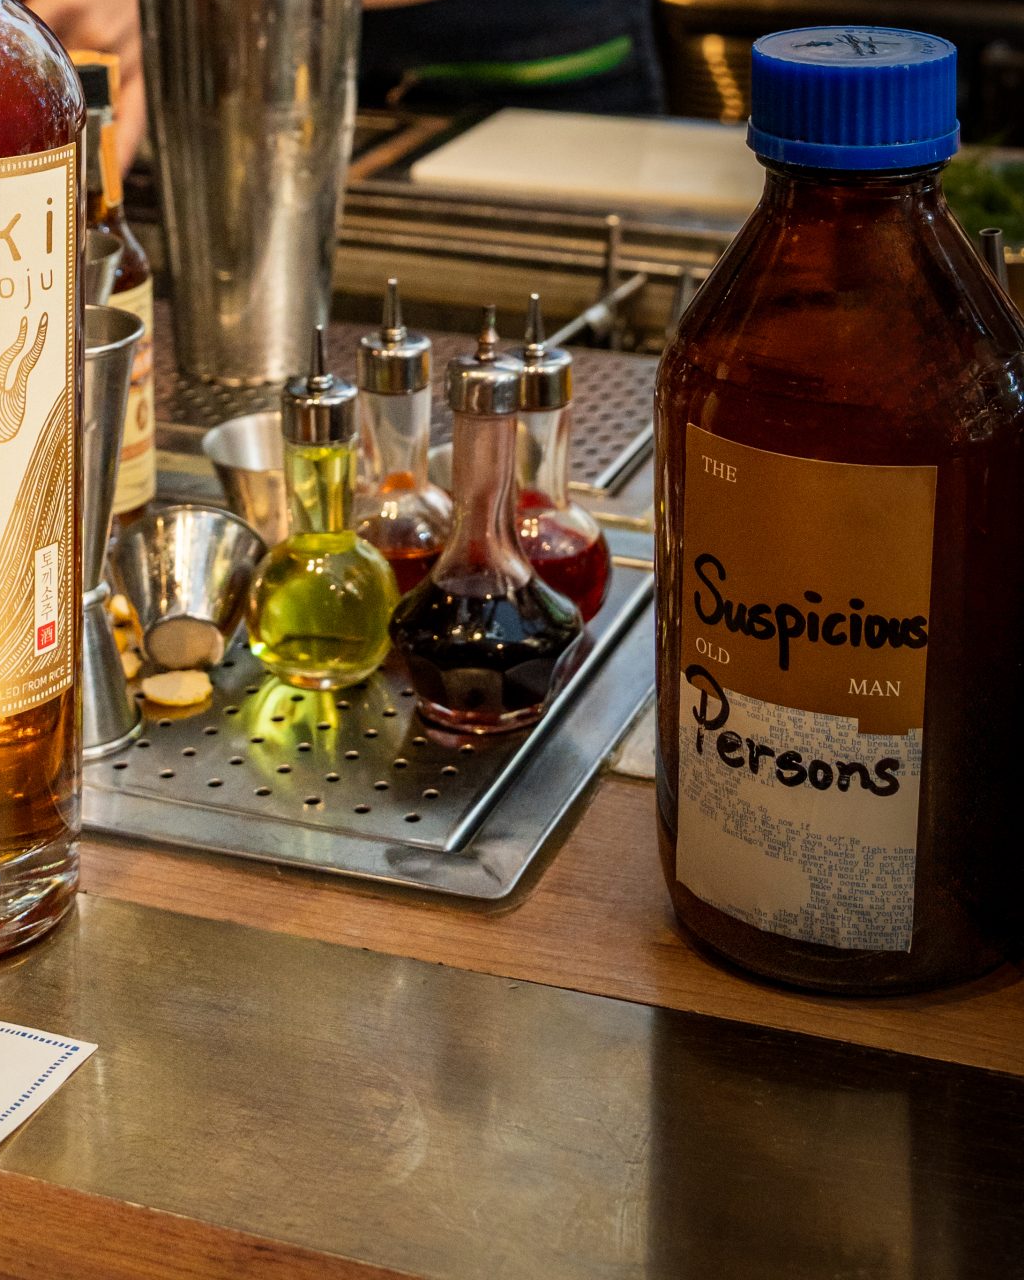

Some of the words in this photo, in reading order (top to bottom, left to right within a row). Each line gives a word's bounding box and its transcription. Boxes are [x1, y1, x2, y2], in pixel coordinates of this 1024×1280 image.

[701, 455, 737, 483] THE
[41, 550, 53, 621] 토끼소주
[694, 553, 928, 671] Suspicious
[695, 637, 730, 665] OLD
[22, 676, 47, 694] FROM
[49, 665, 65, 681] RICE
[848, 678, 901, 697] MAN
[685, 664, 900, 796] Persons
